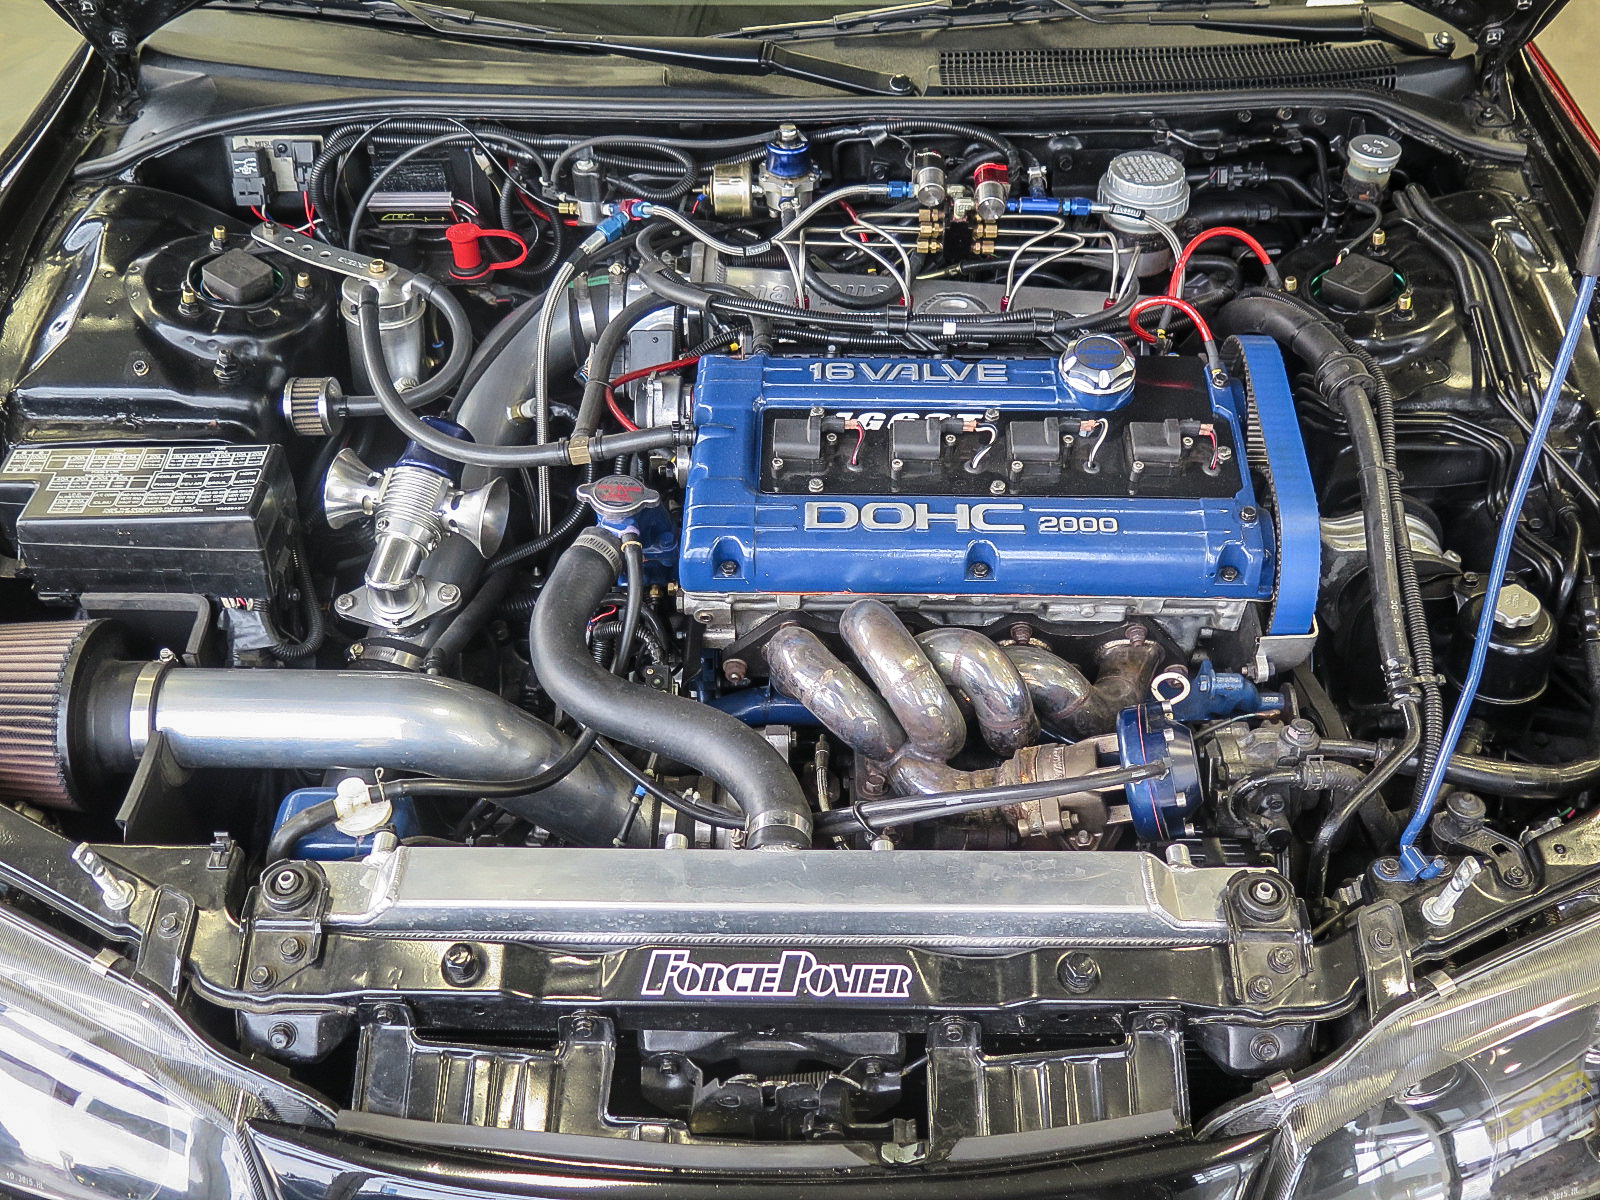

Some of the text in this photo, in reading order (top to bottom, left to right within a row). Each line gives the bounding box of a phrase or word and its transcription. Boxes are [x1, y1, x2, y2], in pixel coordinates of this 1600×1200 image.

[809, 362, 1009, 384] 16 VALVE
[804, 502, 1119, 534] DOHC 2000
